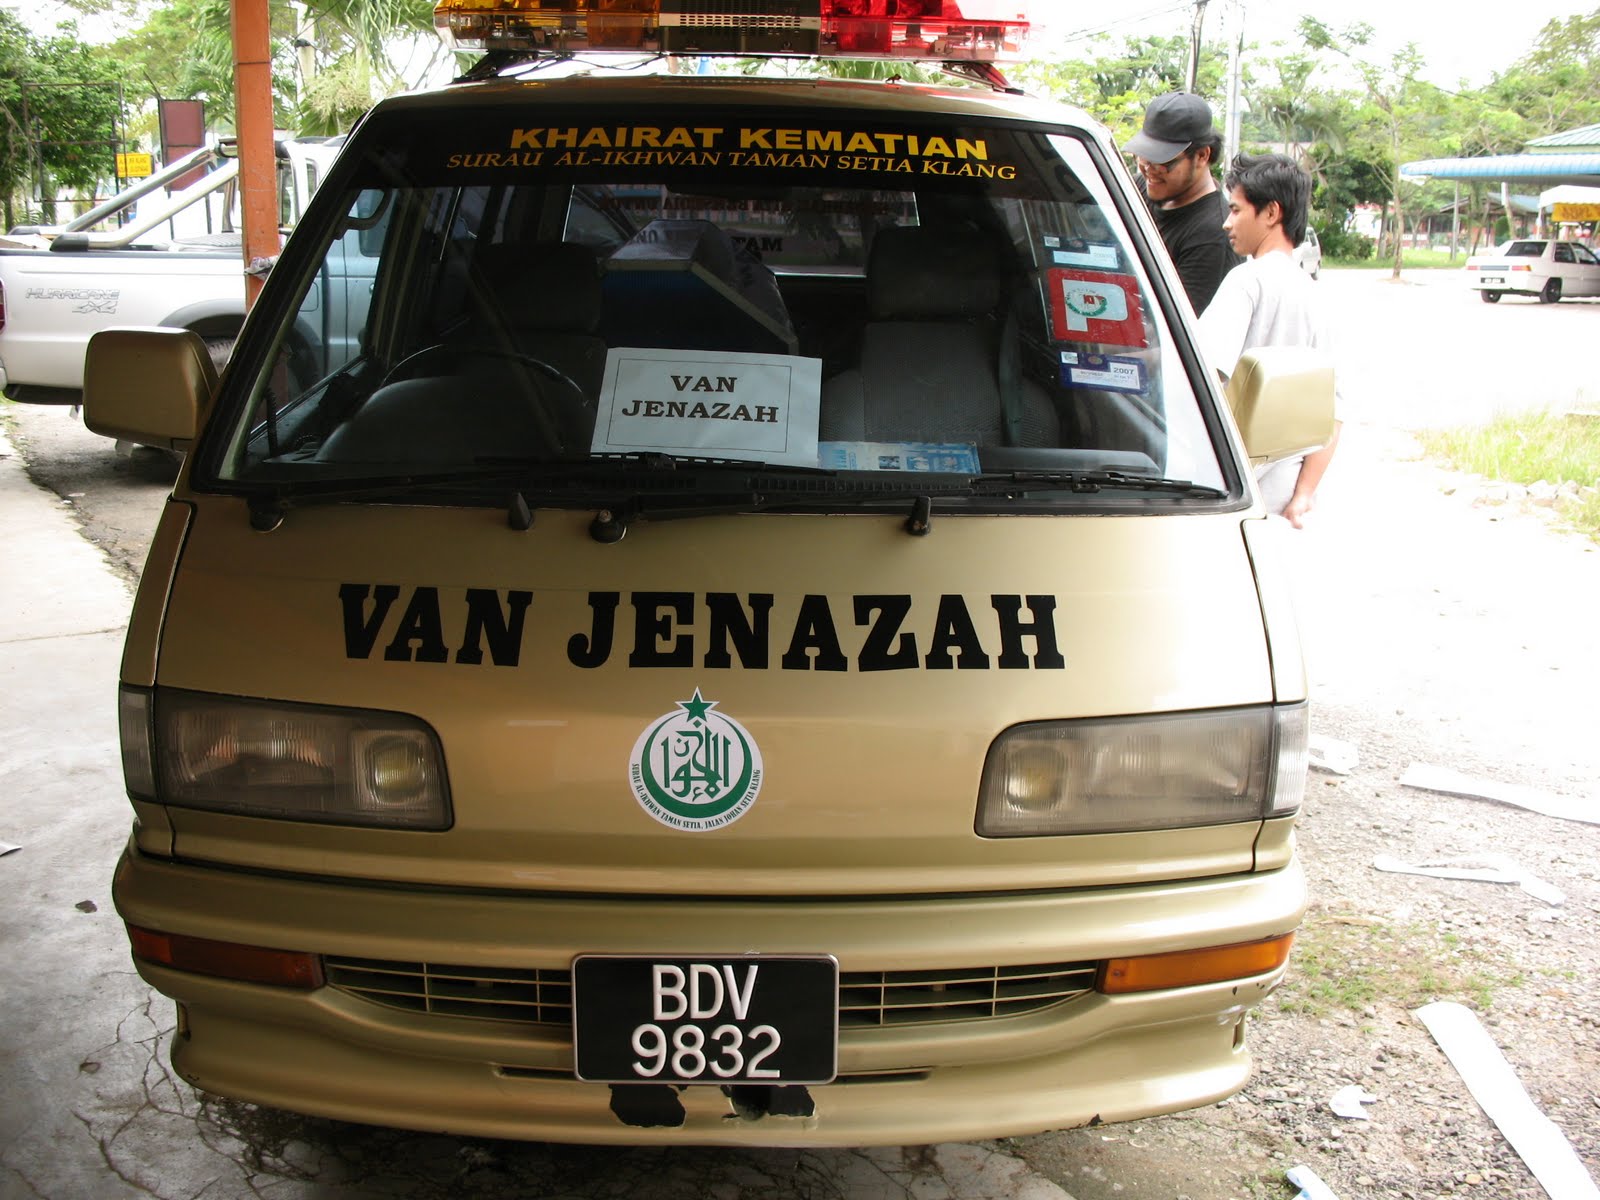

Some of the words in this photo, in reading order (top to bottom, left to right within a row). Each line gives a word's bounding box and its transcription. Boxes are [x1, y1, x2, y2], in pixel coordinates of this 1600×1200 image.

[510, 127, 724, 149] KHAIRAT
[740, 128, 988, 160] KEMATIAN
[446, 152, 544, 168] SURAU
[554, 151, 721, 166] AL-IKHWAN
[728, 152, 830, 169] TAMAN
[837, 155, 914, 173] SETIA
[920, 160, 1017, 180] KLANG
[26, 288, 120, 300] HURRICANE
[1113, 367, 1135, 375] 2007
[670, 375, 738, 393] VAN
[621, 400, 779, 423] JENAZAH
[339, 583, 533, 667] VAN
[567, 591, 1065, 672] JENAZAH
[631, 763, 642, 783] SURAU
[750, 769, 761, 791] KLANG
[636, 784, 662, 816] AL-IKHWAN
[740, 790, 756, 809] SETIA
[660, 811, 682, 827] TAMAN
[704, 816, 725, 829] JALAN
[723, 804, 744, 823] JOHAN
[652, 963, 759, 1021] BDV
[631, 1023, 782, 1078] 9832
